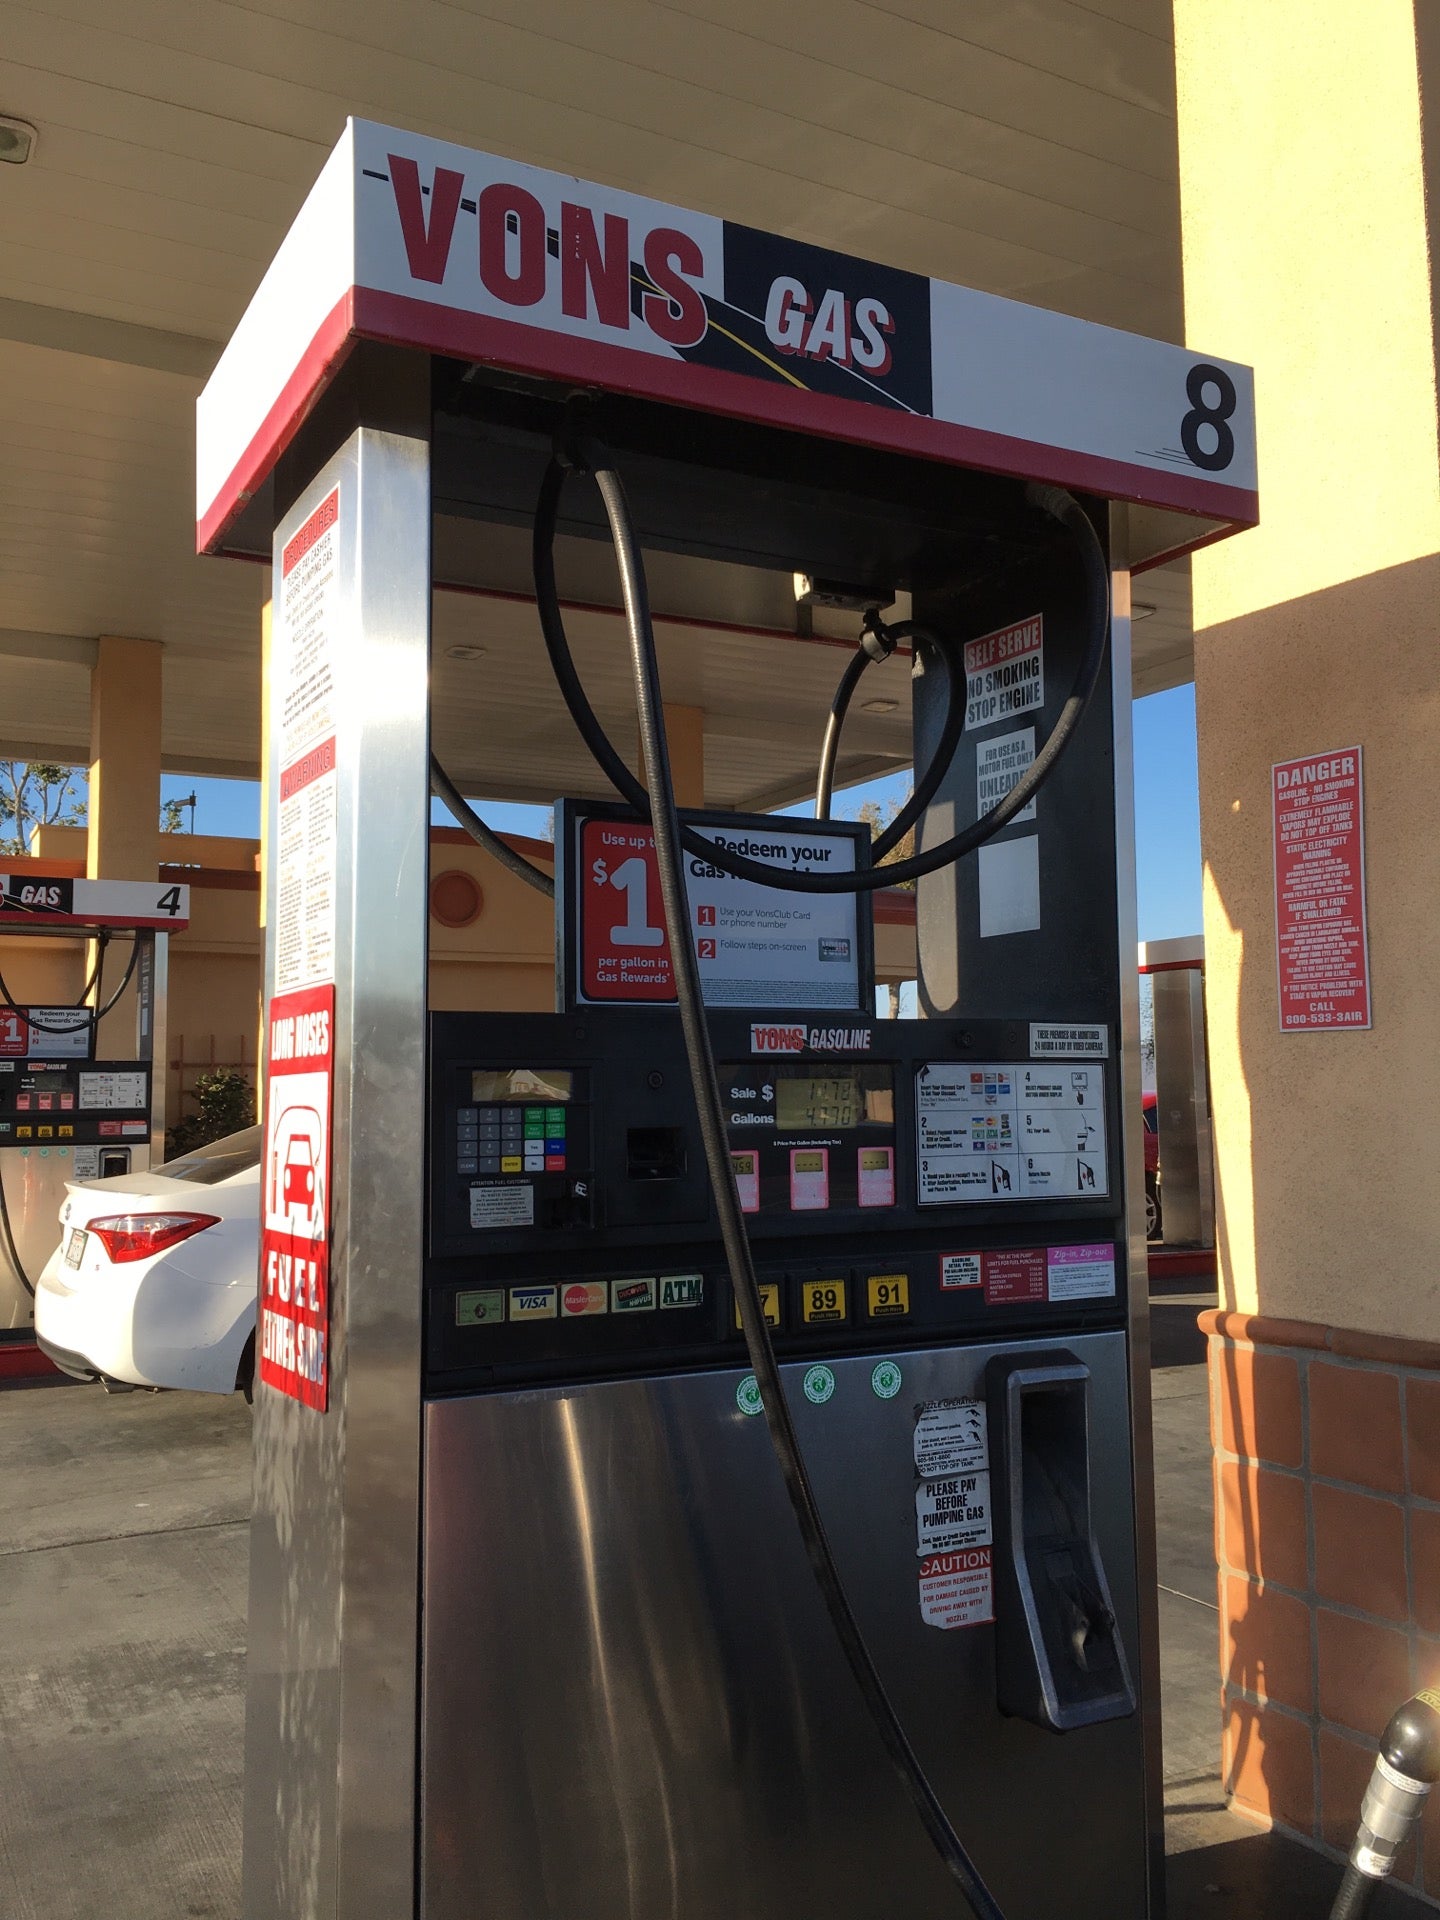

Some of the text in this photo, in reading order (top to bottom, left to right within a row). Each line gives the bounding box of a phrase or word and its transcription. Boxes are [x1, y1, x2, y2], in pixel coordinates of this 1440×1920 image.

[386, 153, 895, 375] VONS GAS
[1181, 364, 1236, 471] 8
[284, 498, 335, 565] PROCEDURES
[967, 622, 1039, 669] SELF SERVE
[969, 656, 1040, 699] NO SMOKING
[968, 681, 1040, 723] STOP ENGINE
[986, 748, 998, 762] FOR
[999, 744, 1010, 759] USE
[1011, 742, 1020, 756] AS
[289, 746, 331, 787] WARNING
[978, 750, 1034, 776] MOTOR FUEL ONLY
[1277, 757, 1354, 790] DANGER
[980, 768, 1030, 799] UNLEAD
[1279, 777, 1355, 801] GASOLINE NO SMOKING
[1294, 790, 1339, 807] STOP ENGINES
[1280, 801, 1354, 823] EXTREMELY FLAMMABLE
[1282, 811, 1351, 831] VAPORS MAY EXPLODE
[1280, 820, 1353, 841] DO NOT TOP OFF TANKS
[602, 832, 646, 850] Use up
[714, 836, 831, 863] Redeem your
[1286, 836, 1348, 854] STATIC ELECTRICITY
[690, 860, 725, 880] Gas
[21, 885, 62, 906] GAS
[157, 887, 181, 916] 4
[1288, 896, 1348, 912] HARMFUL OR FATAL
[702, 907, 811, 925] 1 Use your VonsClub Card
[1295, 907, 1342, 920] IF SWALLOWED
[730, 919, 755, 929] phone
[757, 920, 787, 929] number
[702, 940, 807, 958] 2 Follow steps on-screen
[599, 957, 668, 969] per gallon in
[596, 971, 618, 982] Gas
[64, 1011, 81, 1019] your
[1309, 1001, 1336, 1012] CALL
[1285, 1011, 1363, 1024] 800-533-3AIR
[271, 1009, 330, 1061] LONG HOSES
[754, 1027, 872, 1050] VONS GASOLINE
[1037, 1030, 1049, 1039] THESE
[1049, 1030, 1070, 1040] PREMISES
[1025, 1072, 1031, 1082] 4
[730, 1084, 774, 1102] Sale $
[731, 1113, 775, 1124] Gallons
[921, 1117, 927, 1128] 2
[1026, 1115, 1032, 1126] 5
[922, 1161, 928, 1171] 3
[1028, 1158, 1034, 1169] 6
[1053, 1247, 1108, 1260] Zip-in, Zip-out
[267, 1249, 320, 1313] FUEL
[565, 1294, 605, 1306] MasterCard
[618, 1284, 647, 1298] DISCOVER
[663, 1278, 703, 1304] ATM
[811, 1288, 837, 1310] 89
[877, 1283, 900, 1304] 91
[519, 1296, 547, 1310] VISA
[629, 1295, 652, 1307] NOVUS
[759, 1293, 769, 1313] 7
[811, 1312, 825, 1320] Push
[262, 1308, 325, 1387] EITHER SIDE
[943, 1399, 979, 1407] OPERATION
[926, 1478, 977, 1498] PLEASE PAY
[935, 1493, 968, 1511] BEFORE
[922, 1505, 984, 1528] PUMPING GAS
[919, 1550, 991, 1576] CAUTION
[922, 1572, 988, 1591] CUSTOMER RESPONSIBLE
[923, 1595, 935, 1603] FOR
[935, 1590, 957, 1601] DAMAGE
[959, 1586, 980, 1596] CAUSED
[929, 1597, 983, 1615] DRIVING AWAY WITH
[946, 1613, 968, 1624] NOZZLE!
